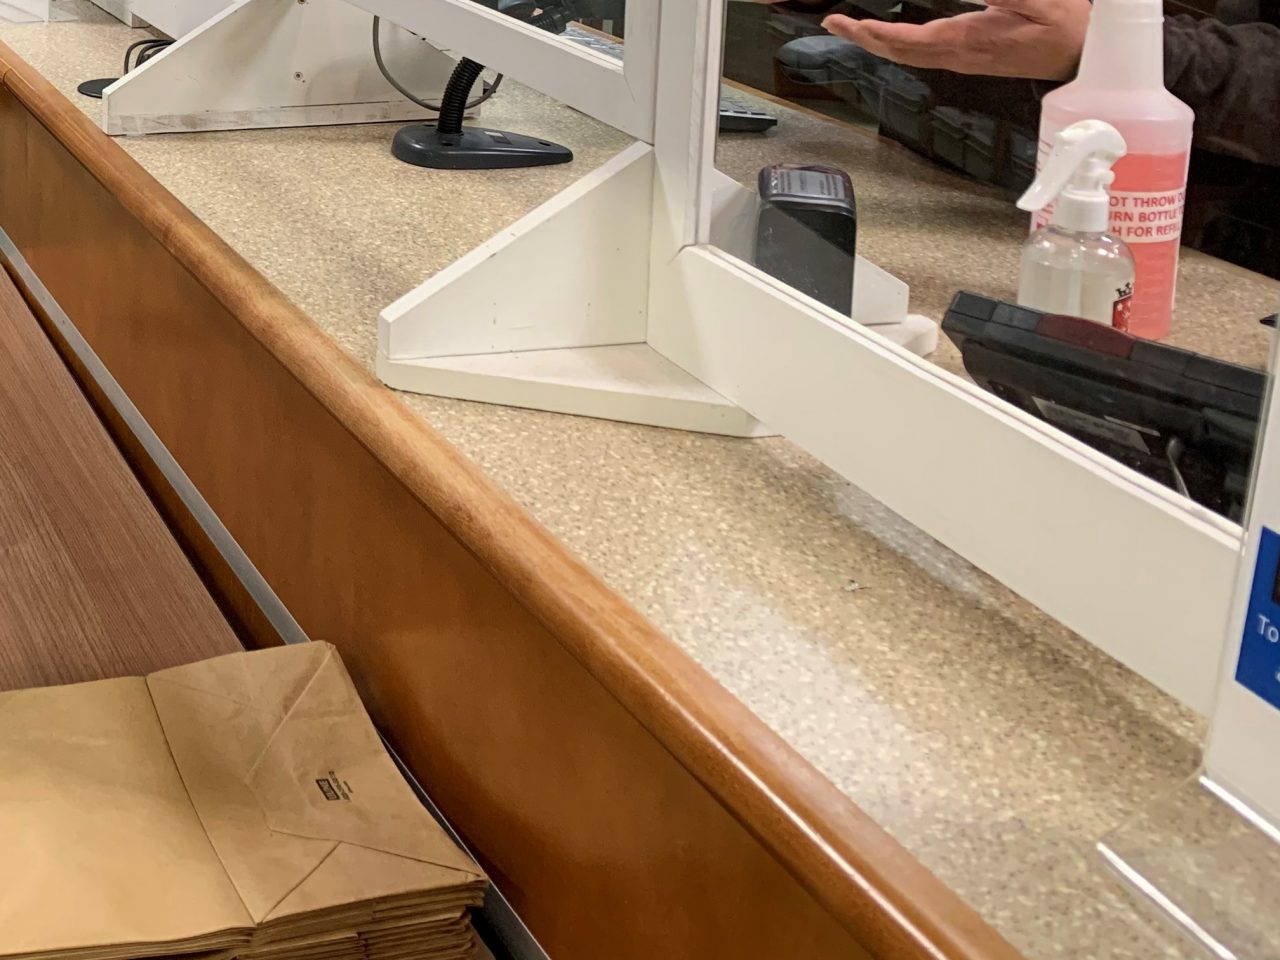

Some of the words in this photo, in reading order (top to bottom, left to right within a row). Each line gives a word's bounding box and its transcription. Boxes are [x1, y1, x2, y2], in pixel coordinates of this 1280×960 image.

[1109, 196, 1128, 208] OT
[1133, 196, 1176, 209] THROW
[1138, 210, 1176, 223] BOTTLE
[1127, 226, 1153, 238] FOR
[1258, 613, 1279, 644] To
